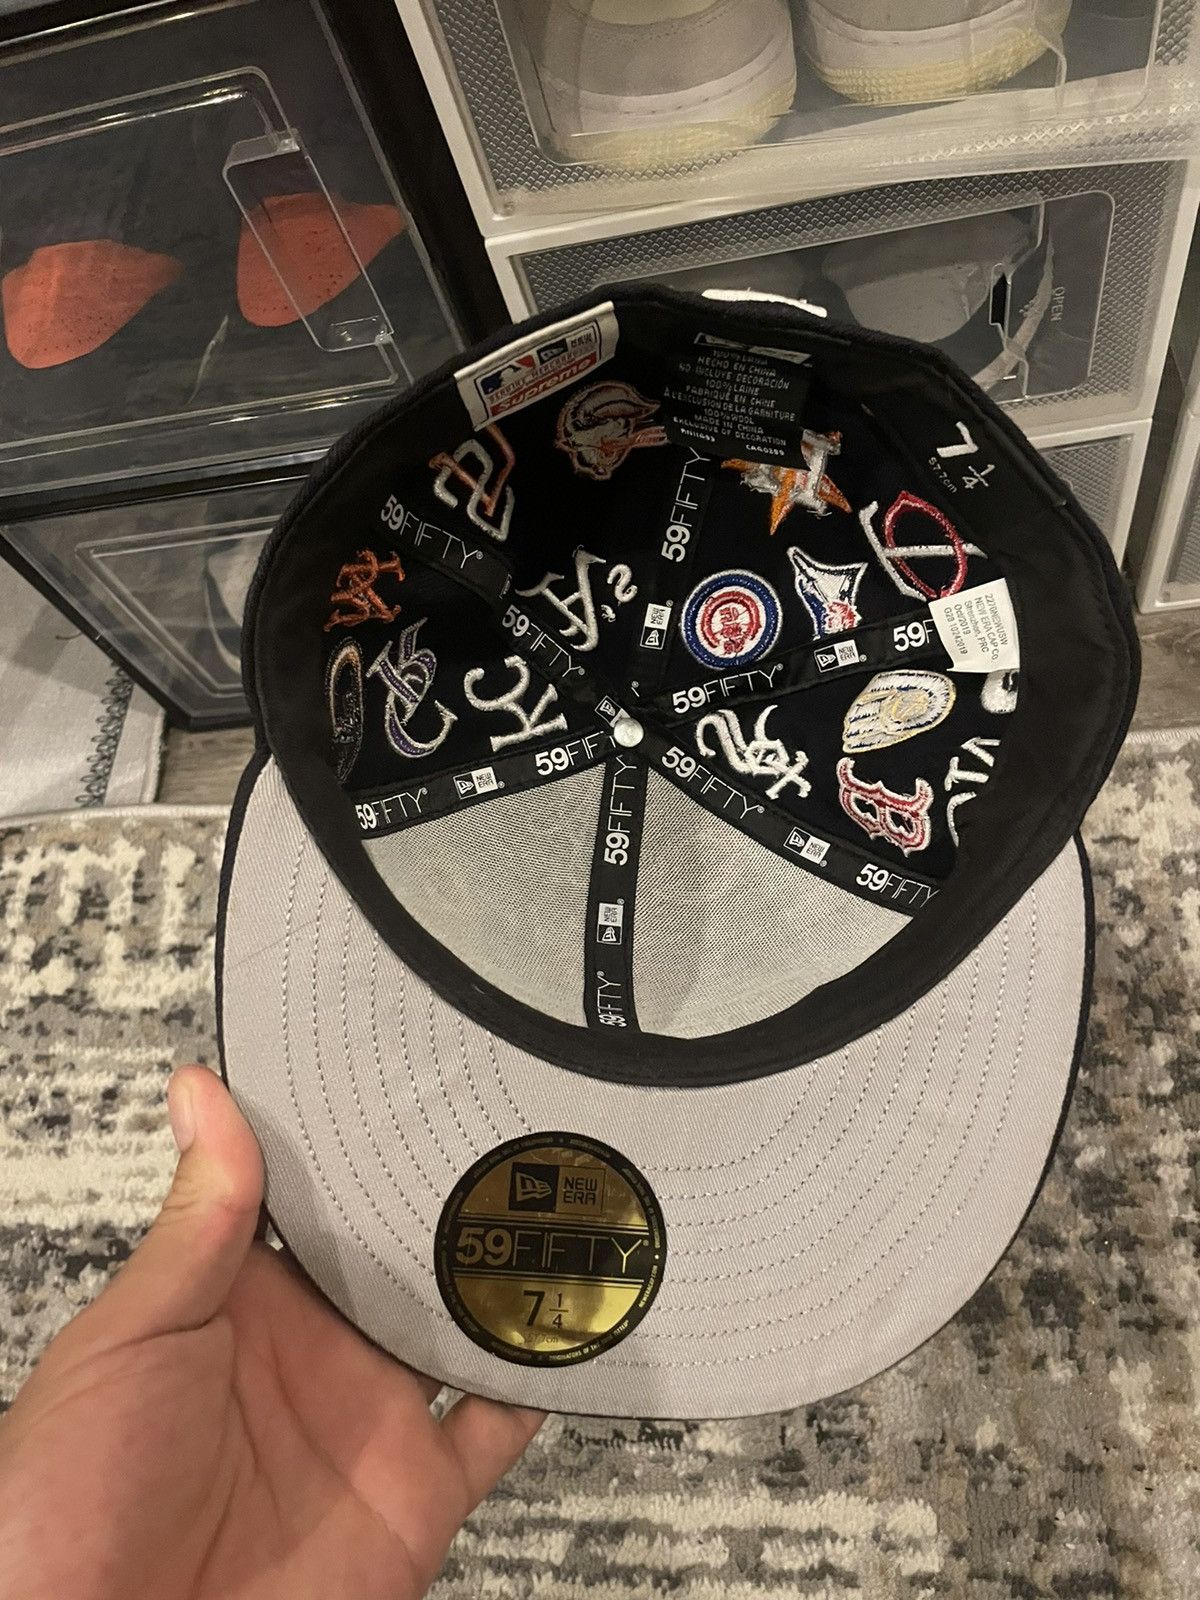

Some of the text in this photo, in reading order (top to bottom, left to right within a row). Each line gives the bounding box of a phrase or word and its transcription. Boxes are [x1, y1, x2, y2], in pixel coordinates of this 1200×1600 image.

[1050, 286, 1066, 321] OPEN
[499, 359, 592, 412] Supreme
[734, 363, 745, 371] EN
[734, 394, 747, 403] EN
[661, 447, 712, 563] 59FIFTY
[381, 494, 480, 568] 59FIFTY
[974, 596, 986, 615] NEW
[981, 615, 992, 632] ERA
[987, 631, 998, 648] CAP
[672, 665, 779, 713] 59FIFTY
[661, 746, 761, 820] 59FIFTY
[604, 755, 637, 866] 59FIFTY
[856, 863, 941, 909] 59FIFTY
[563, 1190, 597, 1205] ERA
[564, 1176, 598, 1191] NEW
[455, 1226, 643, 1274] 59FIFTY
